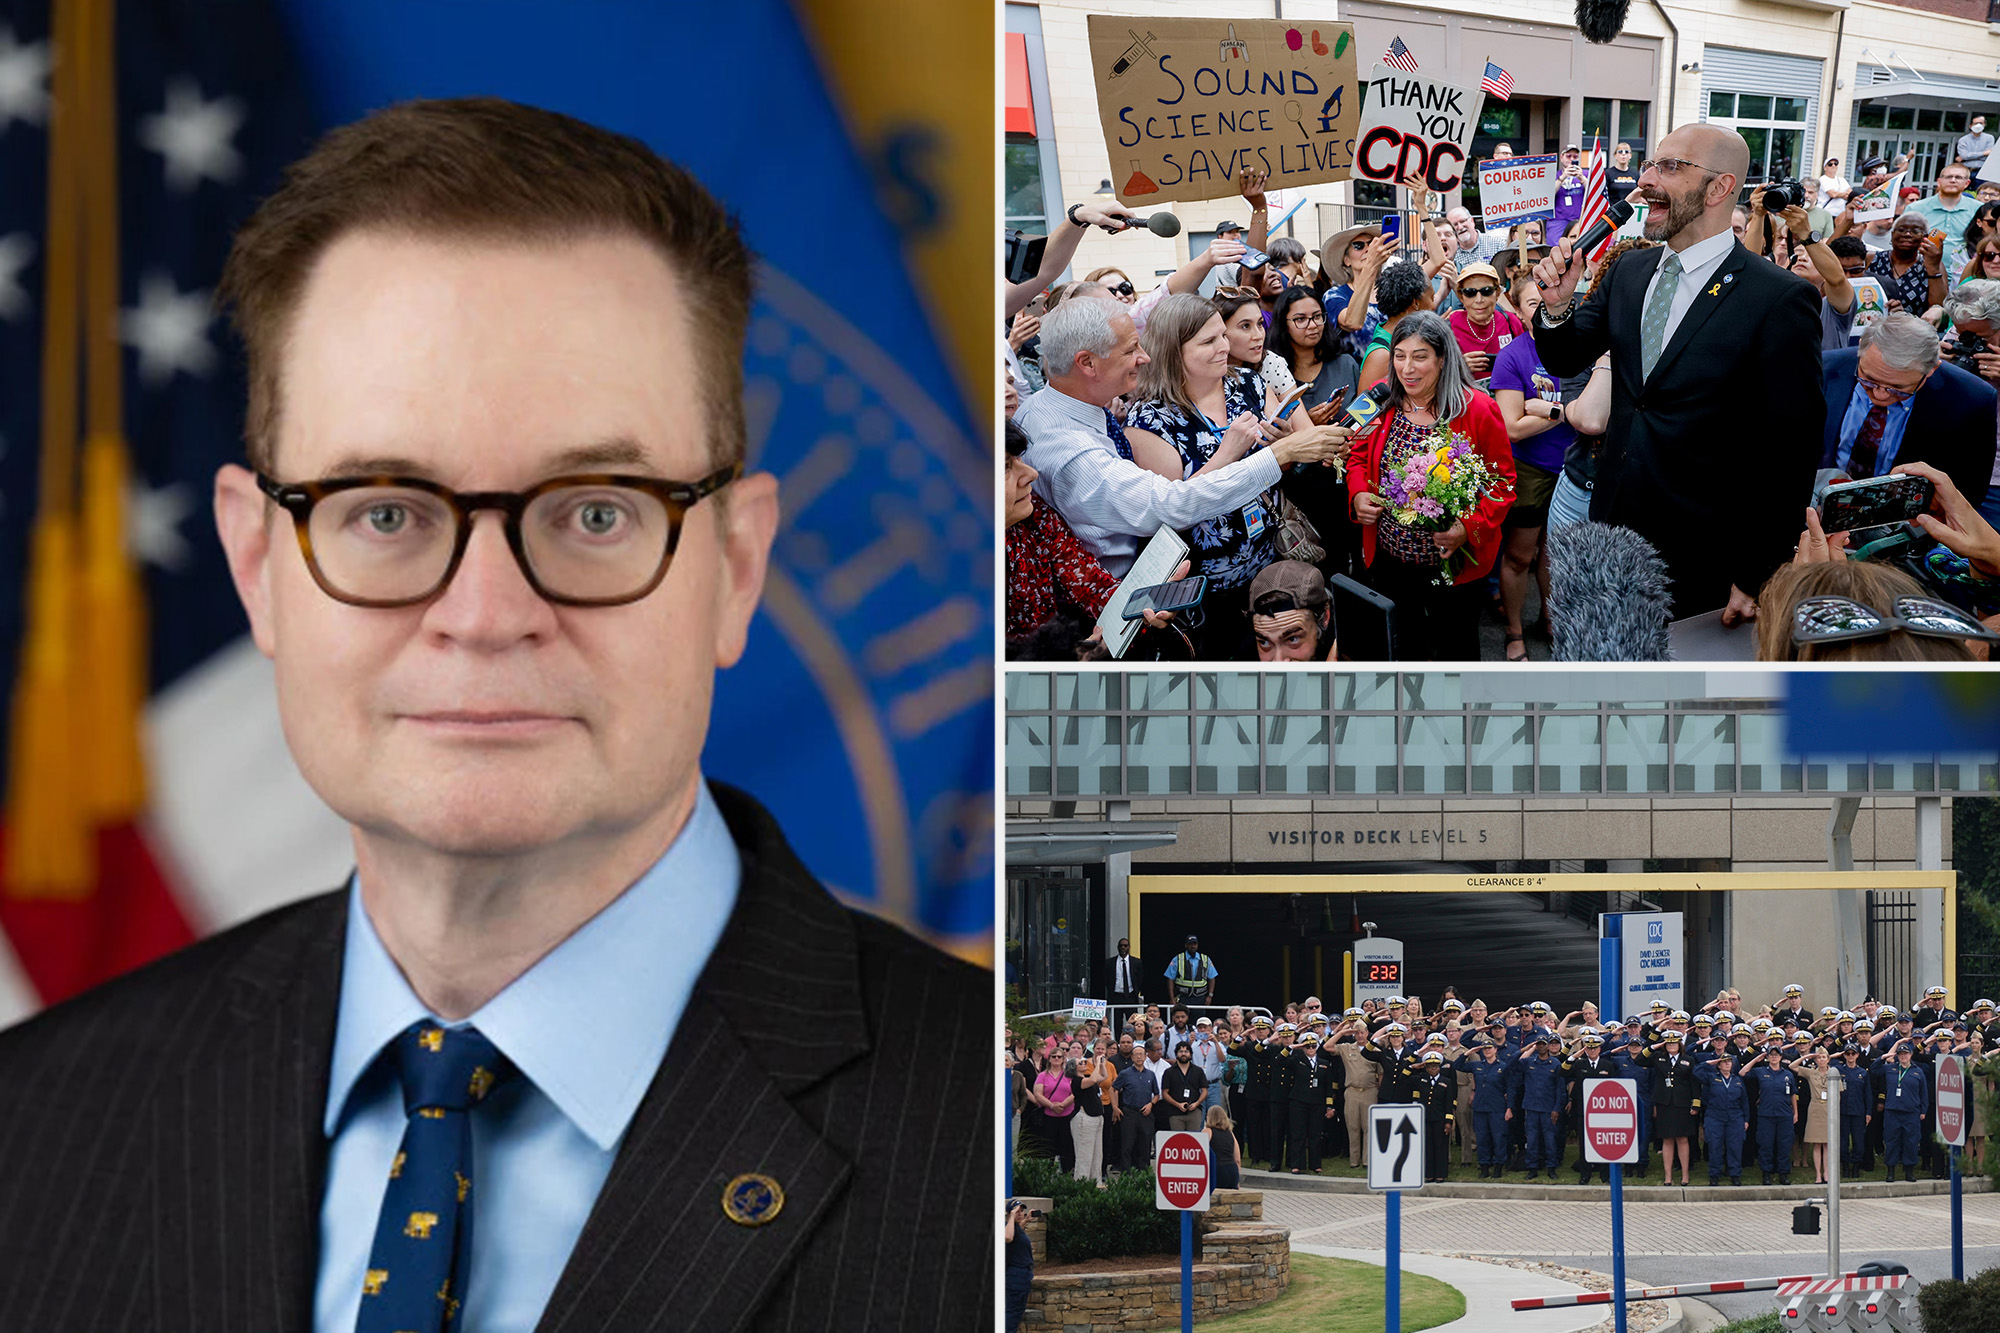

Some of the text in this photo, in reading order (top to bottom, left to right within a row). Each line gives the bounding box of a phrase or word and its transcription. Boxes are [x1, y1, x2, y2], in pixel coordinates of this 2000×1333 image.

[1157, 54, 1319, 105] SOUND
[1370, 77, 1463, 116] THANK
[1118, 106, 1274, 147] SCIENCE
[1416, 111, 1466, 144] YOU
[1158, 139, 1355, 186] SAVES LIVES
[1357, 125, 1465, 193] CDC
[1484, 167, 1546, 186] COURAGE
[1513, 186, 1522, 195] is
[1485, 196, 1549, 216] CONTAGIOUS
[1268, 829, 1488, 845] VISITOR DECK LEVEL 5
[1466, 877, 1525, 886] CLEARANCE
[1648, 923, 1662, 937] CDC
[1651, 959, 1670, 967] MUSEUM
[1370, 965, 1398, 980] 232
[1940, 1073, 1960, 1088] DO NOT
[1592, 1096, 1628, 1109] DO NOT
[1942, 1111, 1959, 1126] ENTER
[1596, 1132, 1627, 1145] ENTER
[1164, 1147, 1201, 1161] DO NOT
[1168, 1181, 1199, 1194] ENTER
